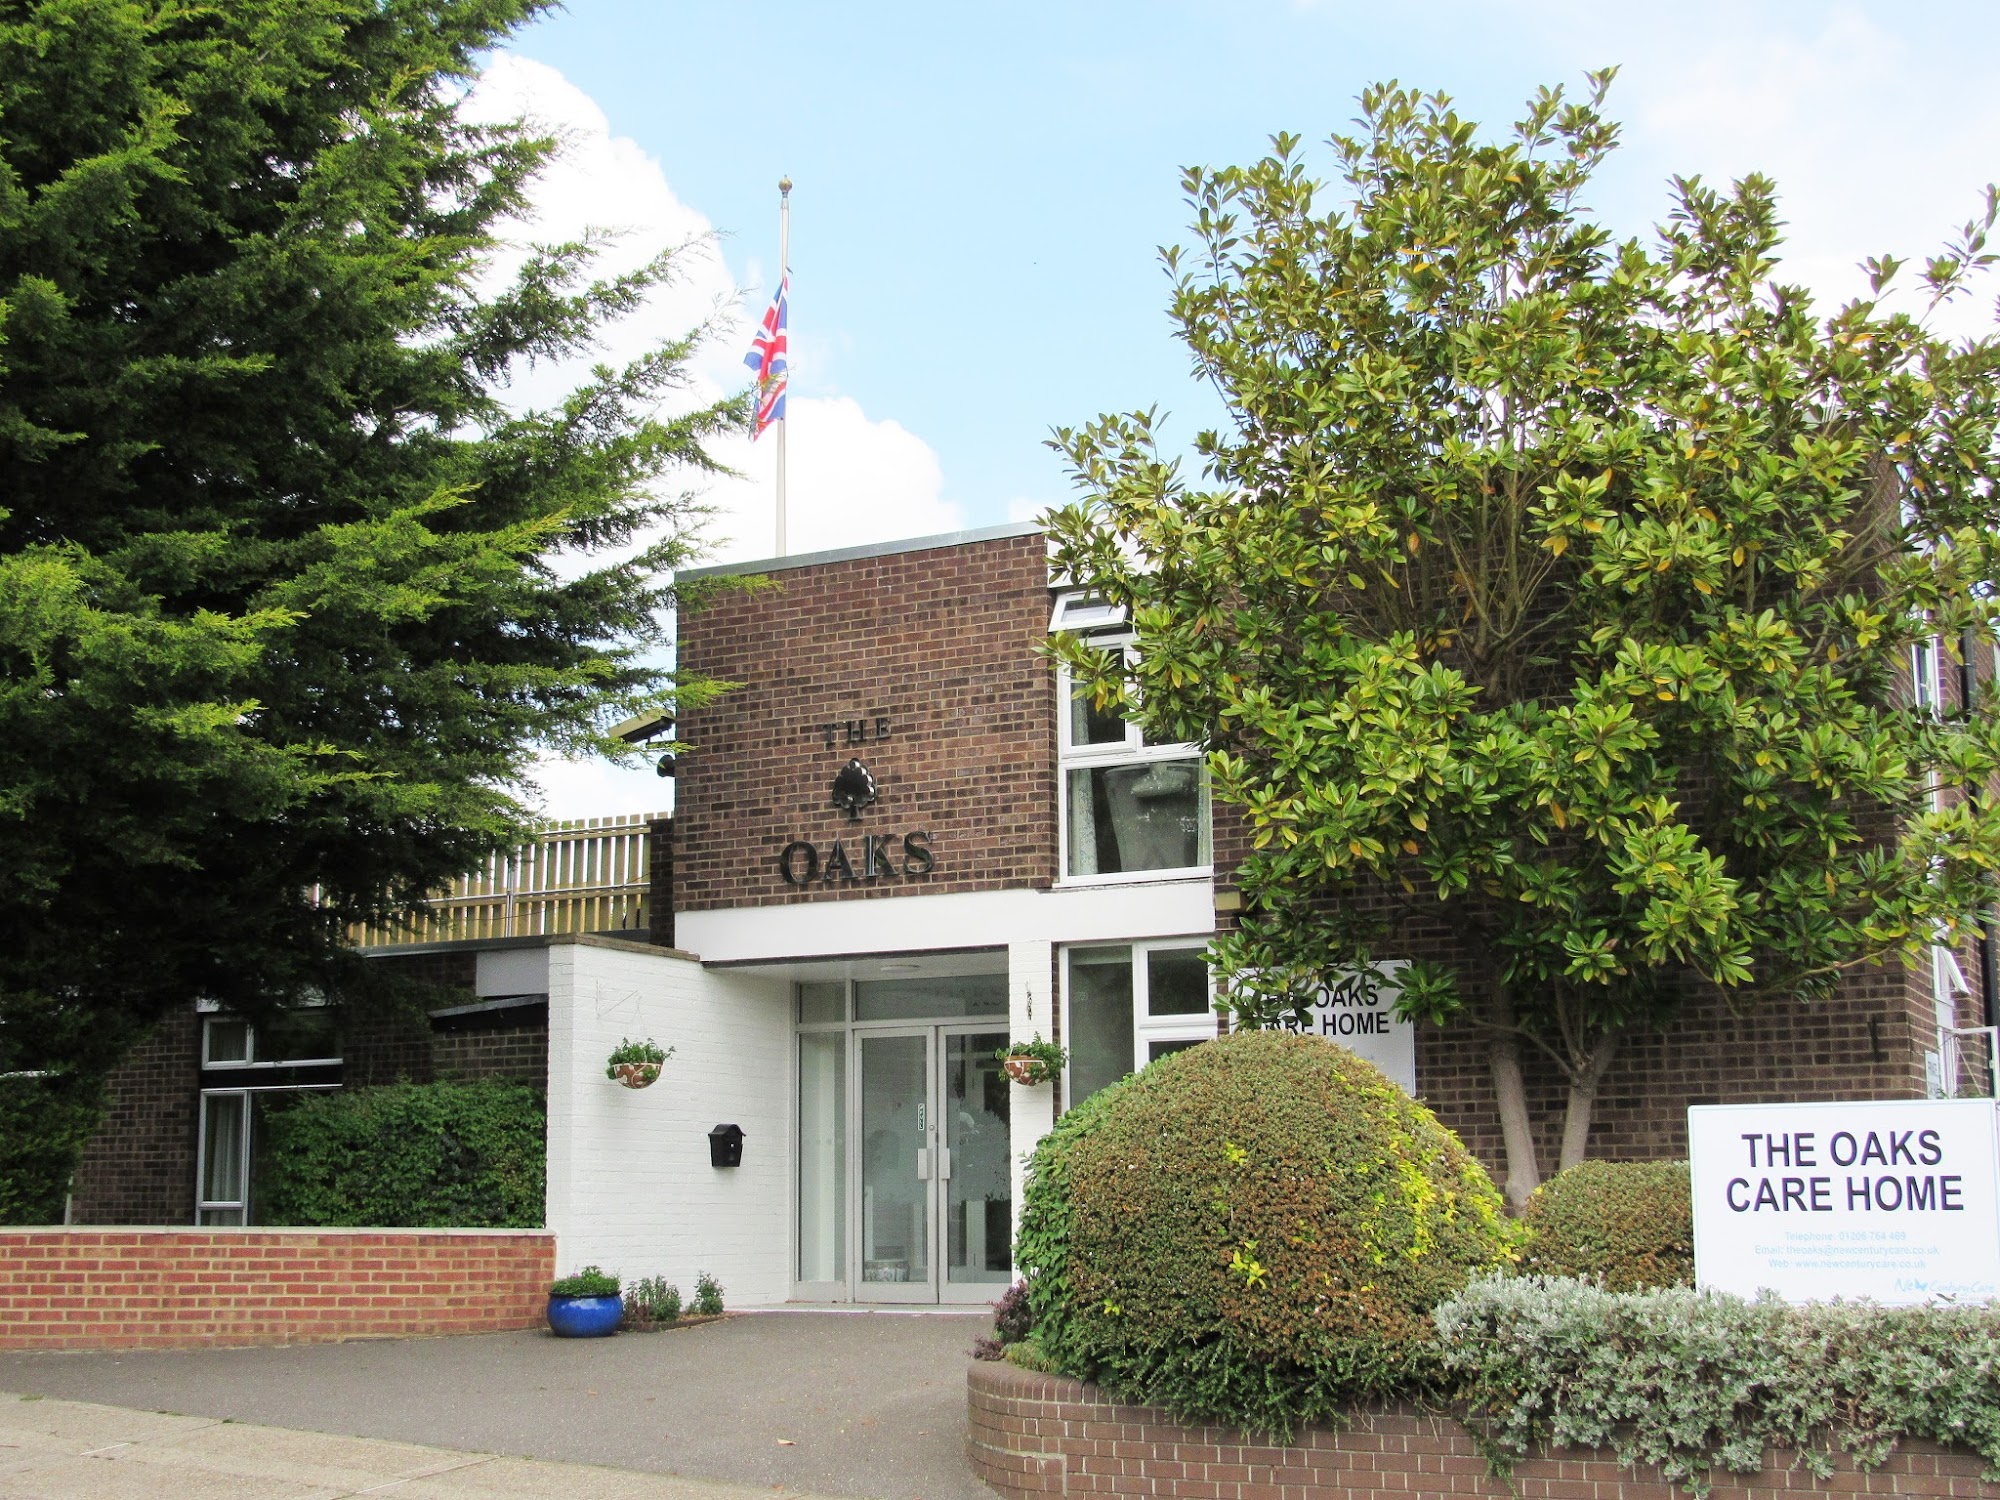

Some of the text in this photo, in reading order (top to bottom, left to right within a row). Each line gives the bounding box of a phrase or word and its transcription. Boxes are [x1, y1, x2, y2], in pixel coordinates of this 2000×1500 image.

[821, 717, 892, 745] THE
[779, 830, 935, 884] OAKS
[1314, 984, 1379, 1009] OAKS
[1322, 1011, 1390, 1036] HOME
[1741, 1129, 1943, 1168] THE OAKS
[1726, 1175, 1965, 1213] CARE HOME
[1785, 1231, 1836, 1242] Telephone:
[1839, 1231, 1867, 1241] 01206
[1869, 1231, 1886, 1241] 764
[1754, 1245, 1783, 1255] Email:
